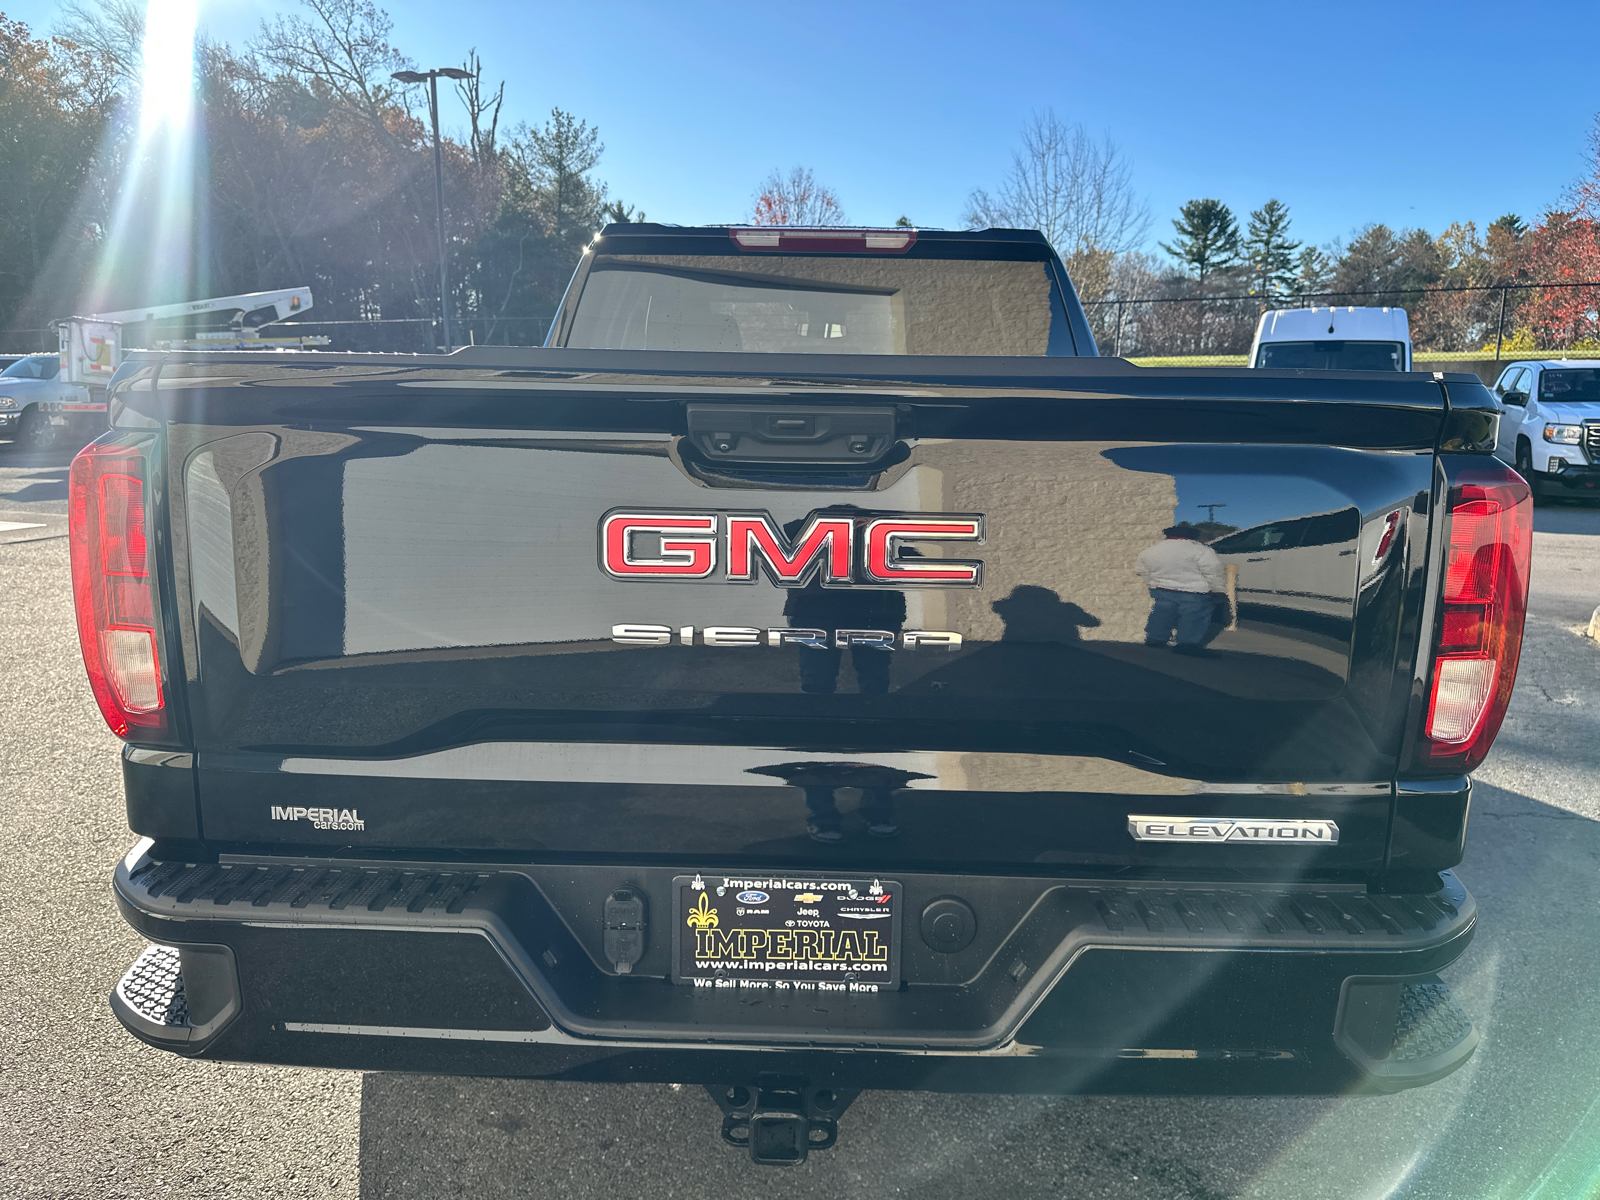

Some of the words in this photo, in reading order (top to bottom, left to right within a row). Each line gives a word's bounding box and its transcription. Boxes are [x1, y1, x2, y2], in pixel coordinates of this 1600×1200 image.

[600, 508, 985, 588] GMC
[611, 623, 964, 652] SIERRA
[270, 806, 365, 824] IMPERIAL
[313, 821, 365, 831] cars.com
[1145, 824, 1324, 839] ELEVATION
[723, 877, 852, 891] Imperialcars.com
[796, 907, 819, 918] Jeep
[796, 920, 830, 928] TOYOTA
[695, 928, 888, 961] IMPERIAL
[695, 960, 888, 972] www.imperialcars.com
[693, 978, 713, 988] We
[715, 979, 736, 988] Sell
[775, 981, 790, 989] So
[792, 981, 816, 990] You
[818, 982, 846, 991] Save
[849, 982, 879, 993] More
